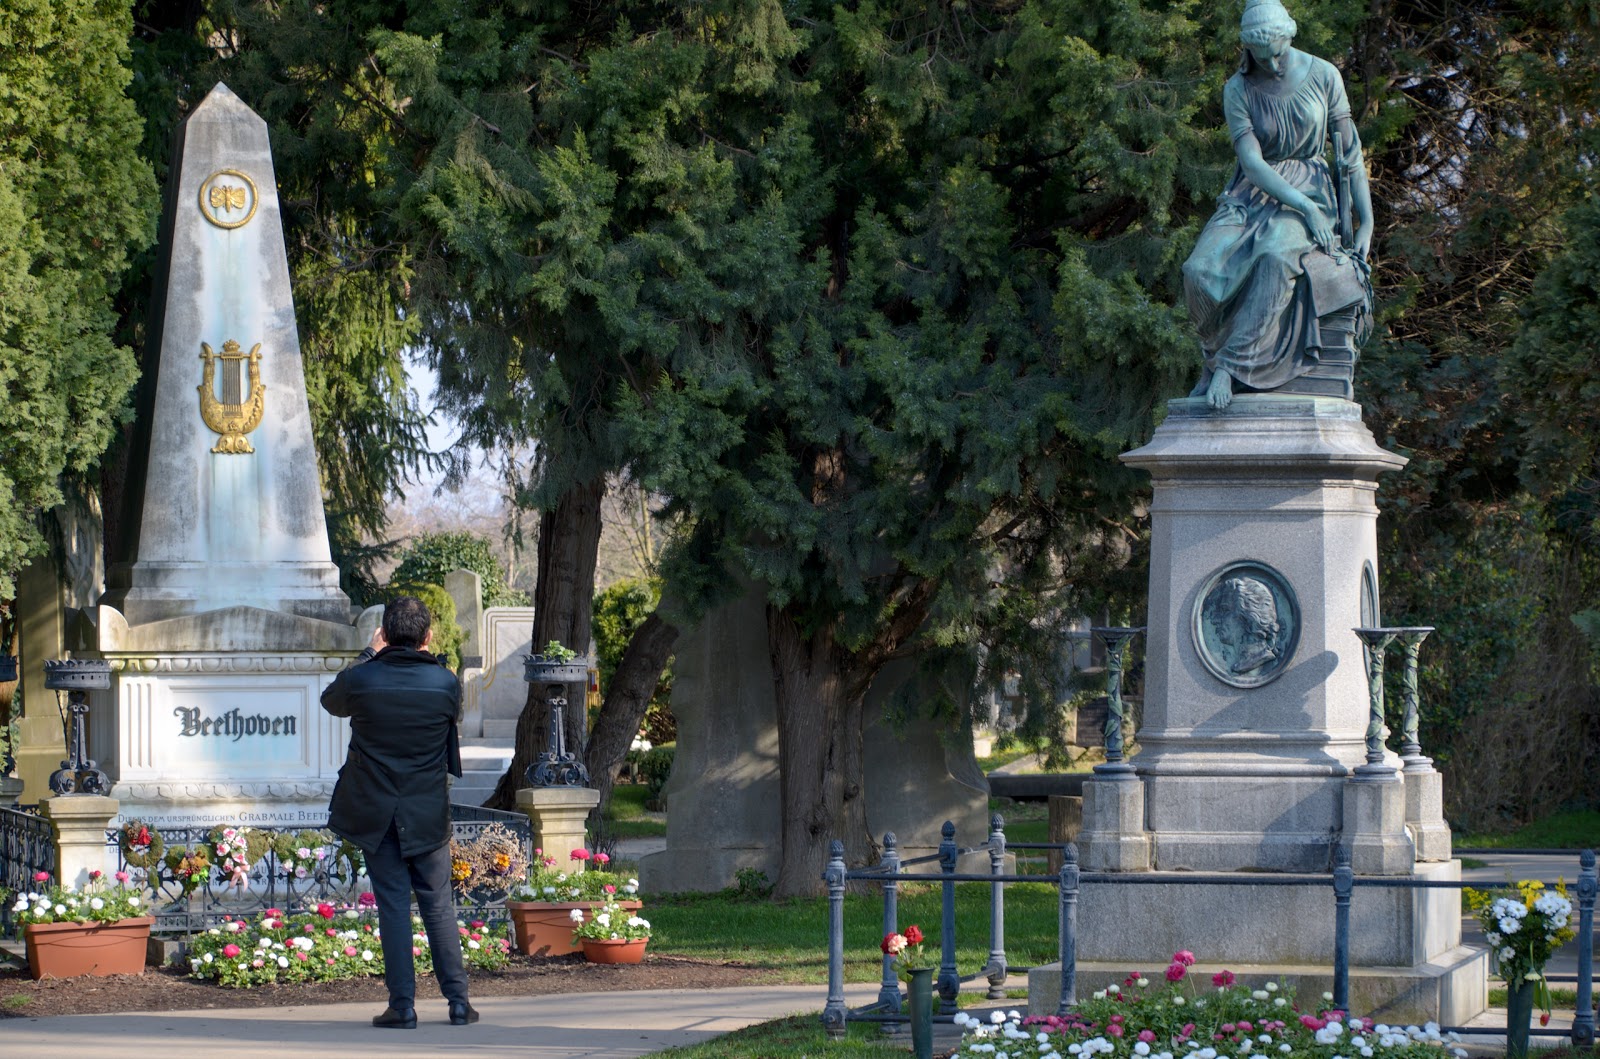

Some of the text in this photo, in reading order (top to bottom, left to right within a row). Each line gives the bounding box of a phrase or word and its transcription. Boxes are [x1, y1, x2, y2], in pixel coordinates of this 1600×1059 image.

[173, 706, 297, 742] Beethoven
[148, 815, 165, 823] DEM
[167, 814, 235, 823] URSPRÜNGLICHEN
[239, 811, 295, 822] GRABMALE
